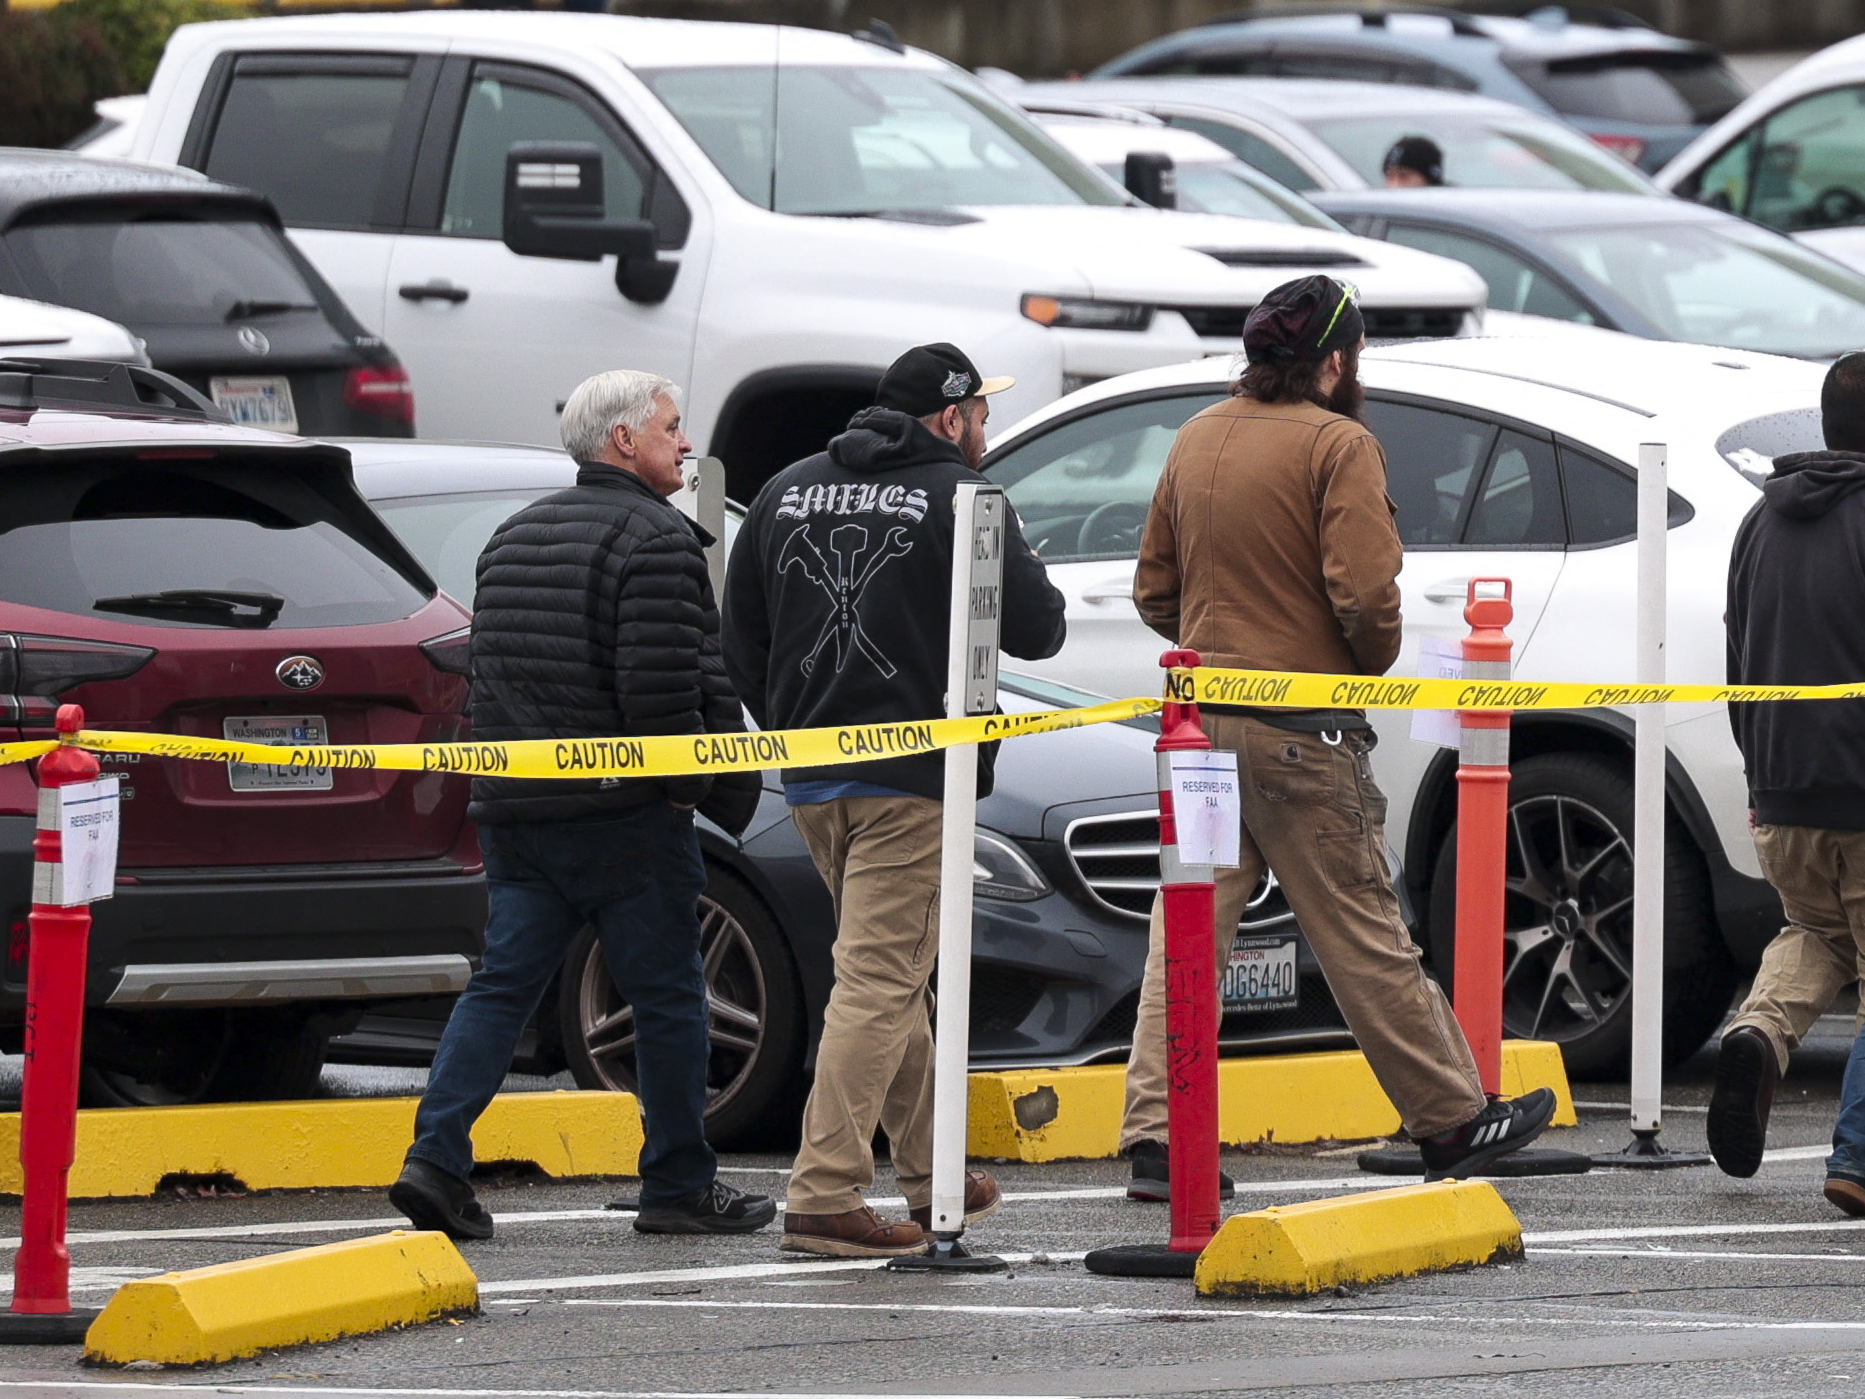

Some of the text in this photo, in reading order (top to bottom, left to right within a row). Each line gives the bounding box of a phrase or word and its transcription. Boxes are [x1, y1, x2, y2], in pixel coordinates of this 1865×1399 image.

[233, 728, 287, 738] WASHINGTON
[288, 750, 376, 769] CAUTION
[423, 746, 509, 771] CAUTION
[555, 741, 645, 770] CAUTION
[694, 735, 789, 765] CAUTION
[838, 724, 936, 756] CAUTION
[1182, 780, 1233, 793] RESERVED FOR
[1205, 797, 1219, 808] FAA
[70, 811, 114, 828] RESERVED FOR
[1229, 951, 1264, 962] HINGTON
[1224, 961, 1293, 998] DG6440
